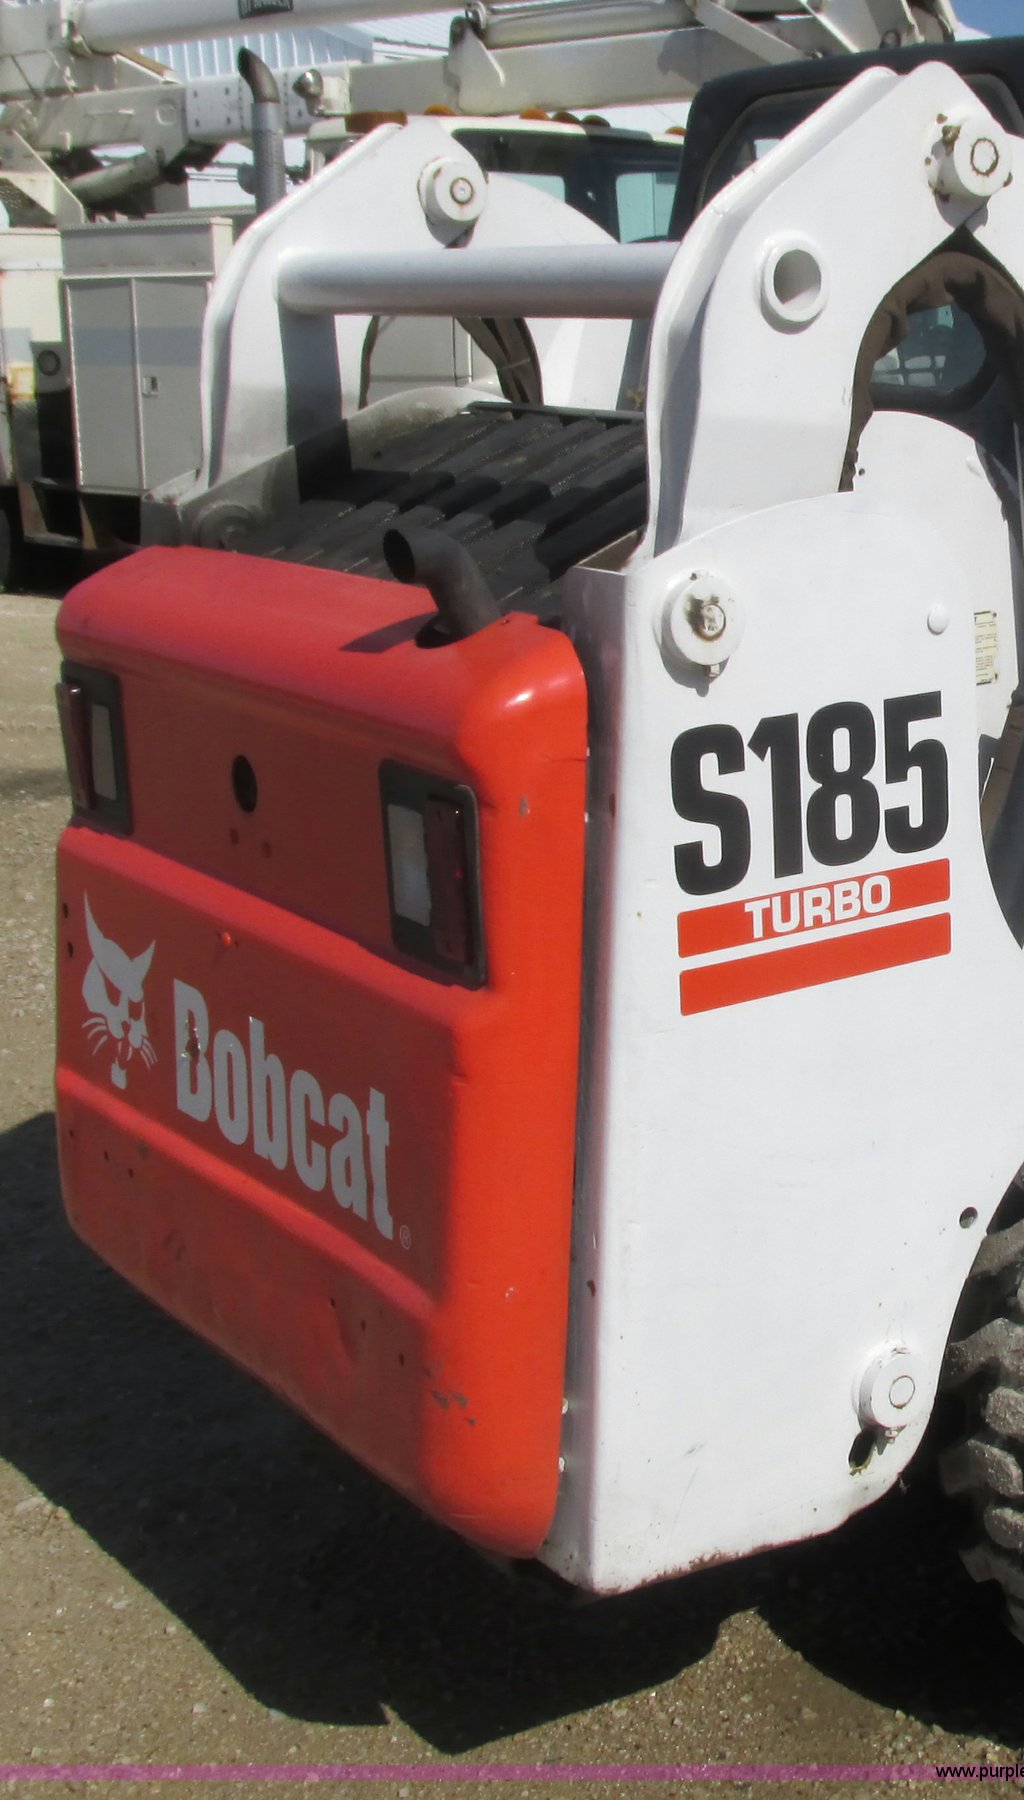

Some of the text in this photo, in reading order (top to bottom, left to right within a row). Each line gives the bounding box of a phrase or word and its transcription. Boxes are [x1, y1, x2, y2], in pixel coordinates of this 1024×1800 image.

[670, 690, 950, 896] S185
[744, 874, 892, 939] TURBO
[173, 978, 394, 1241] Bobcat
